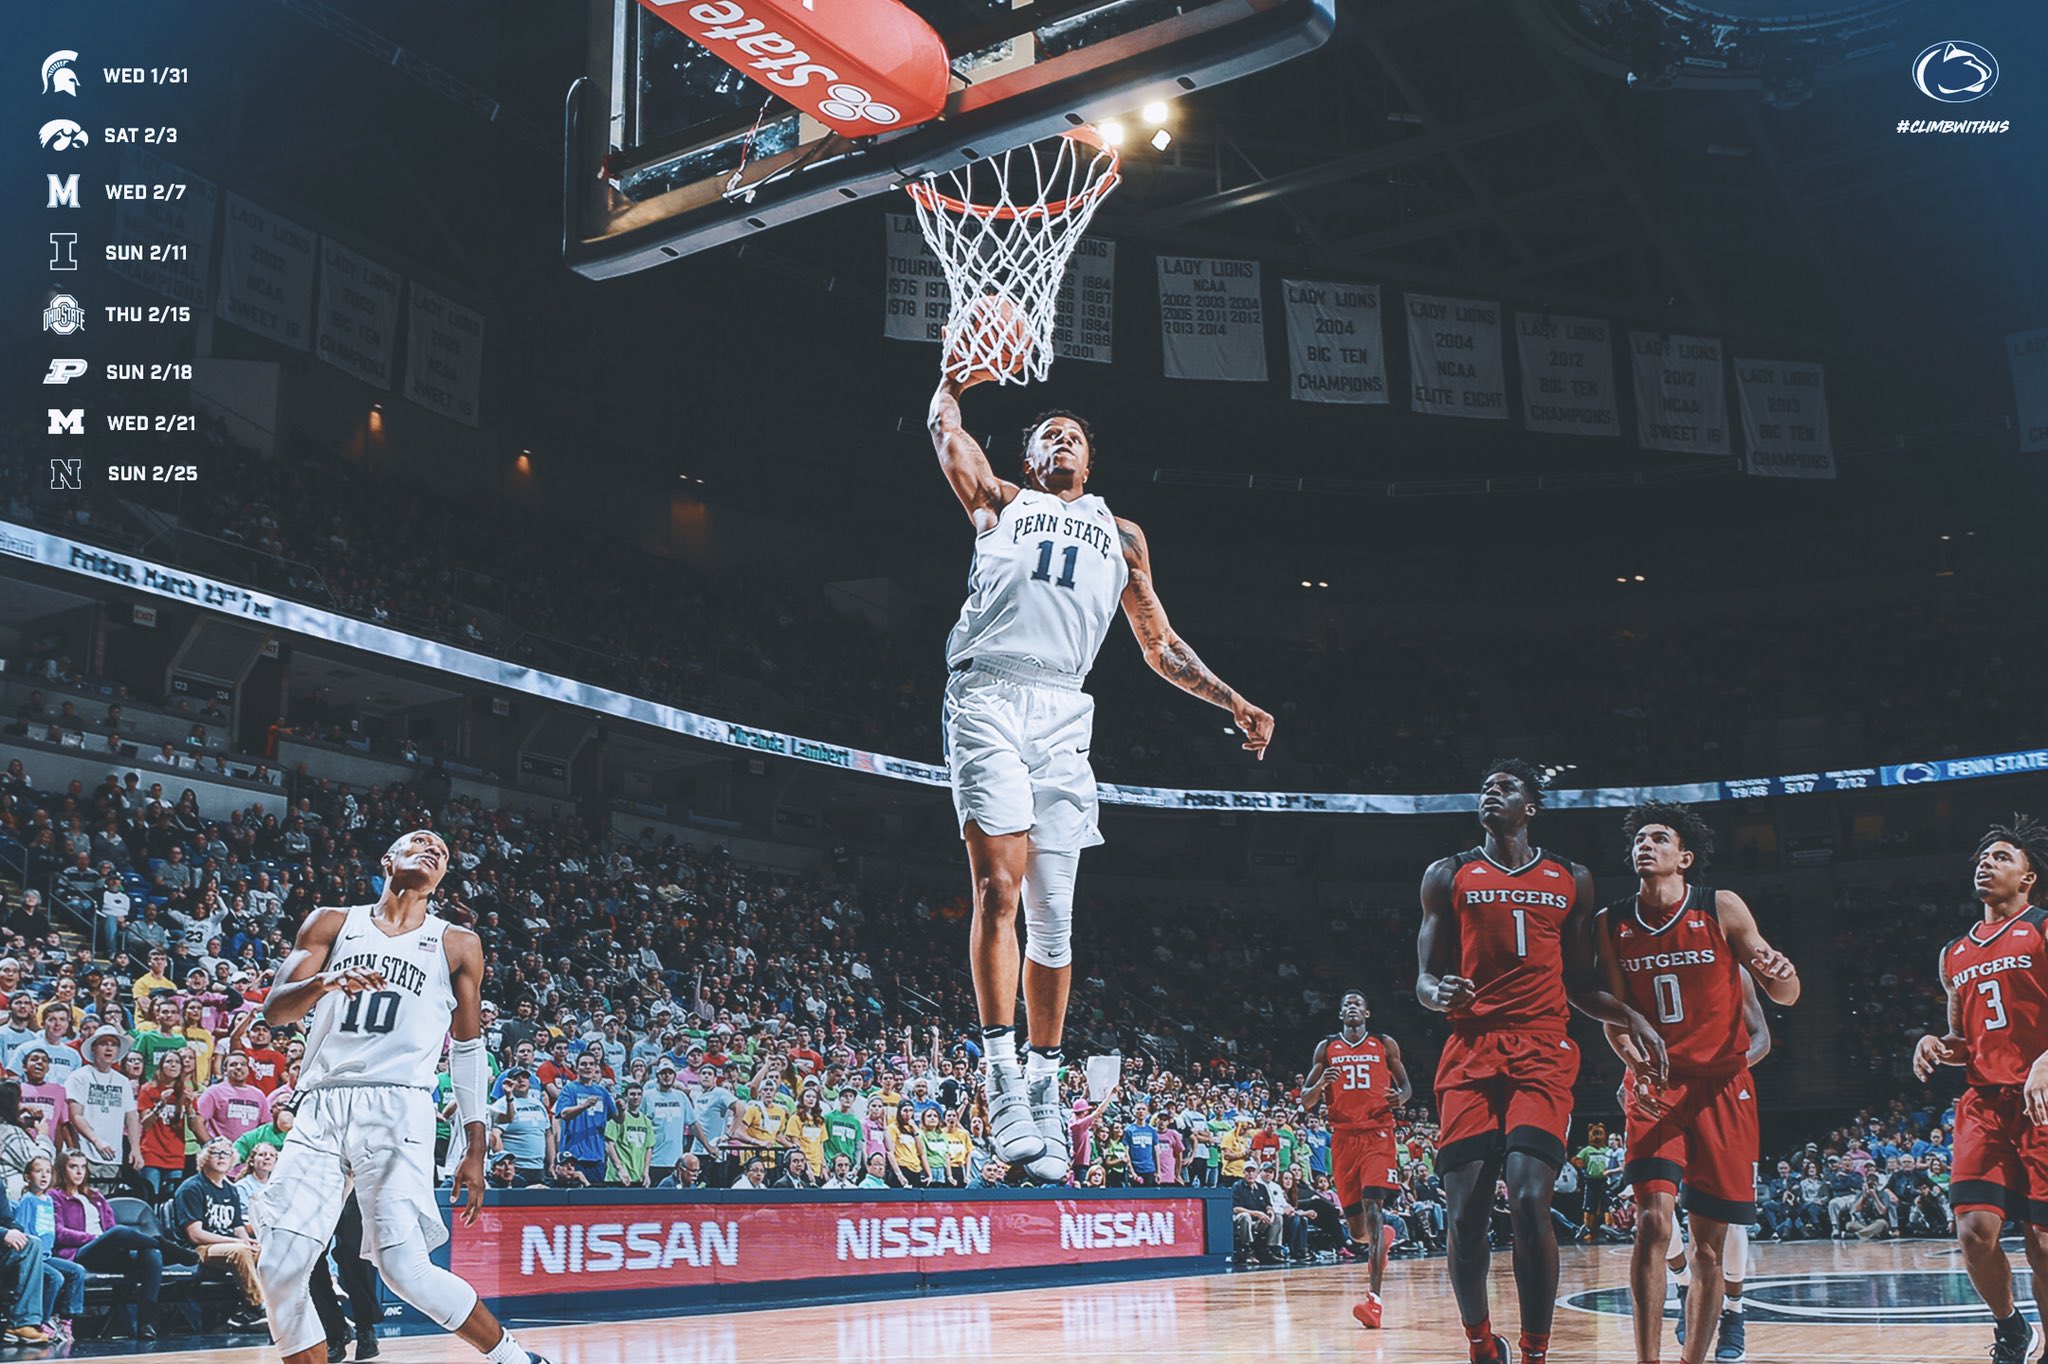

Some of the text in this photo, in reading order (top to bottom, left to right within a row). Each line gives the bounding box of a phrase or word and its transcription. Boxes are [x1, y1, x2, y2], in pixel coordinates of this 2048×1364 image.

[689, 0, 838, 87] State
[230, 203, 311, 254] LADY LIONS
[324, 248, 396, 297] LADY LIONS
[1164, 258, 1253, 278] LADY LIONS
[247, 273, 286, 302] NCAA
[889, 278, 918, 296] 1975
[1193, 279, 1227, 293] NCAA
[1162, 293, 1260, 310] 2002 2003 2004
[1289, 288, 1377, 309] LADY LIONS
[228, 295, 278, 329] SWEET
[1163, 308, 1261, 324] 2005 2011 2012
[1409, 302, 1495, 325] LADY LIONS
[1164, 321, 1228, 336] 2013 2014
[1315, 318, 1355, 335] 2004
[1522, 320, 1605, 343] LADY LIONS
[1063, 343, 1094, 358] 2001
[1435, 332, 1475, 351] 2004
[1636, 340, 1717, 361] LADY LIONS
[1307, 346, 1368, 364] BIG TEN
[1550, 351, 1584, 368] 2012
[1437, 361, 1477, 379] NCAA
[1663, 369, 1696, 387] 2012
[1740, 369, 1820, 387] LADY LIONS
[1297, 373, 1383, 392] CHAMPIONS
[1539, 377, 1598, 397] BIG TEN
[1415, 386, 1503, 408] ELITE EIGHT
[1663, 397, 1701, 415] NCAA
[1530, 405, 1612, 425] CHAMPIONS
[1649, 424, 1721, 443] SWEET 16
[1759, 423, 1815, 442] BIG TEN
[1752, 450, 1829, 469] CHAMPIONS
[1013, 513, 1112, 559] PENN STATE
[1030, 540, 1079, 590] 11
[143, 566, 199, 601] March
[791, 737, 850, 767] Lambert
[1946, 752, 2047, 777] PENN STATE
[1466, 890, 1567, 909] RUTGERS
[186, 930, 203, 943] 23
[1512, 909, 1528, 957] 1
[381, 955, 427, 997] STATE
[1952, 955, 2032, 989] RUTGERS
[1653, 973, 1685, 1024] 0
[1977, 980, 2007, 1030] 3
[340, 990, 402, 1034] 10
[1331, 1054, 1380, 1064] RUTGERS
[1342, 1064, 1371, 1090] 35
[1387, 1168, 1399, 1184] R
[836, 1215, 992, 1261] NISSAN
[1060, 1211, 1176, 1250] NISSAN
[519, 1221, 740, 1275] NISSAN
[384, 1306, 403, 1316] ANC
